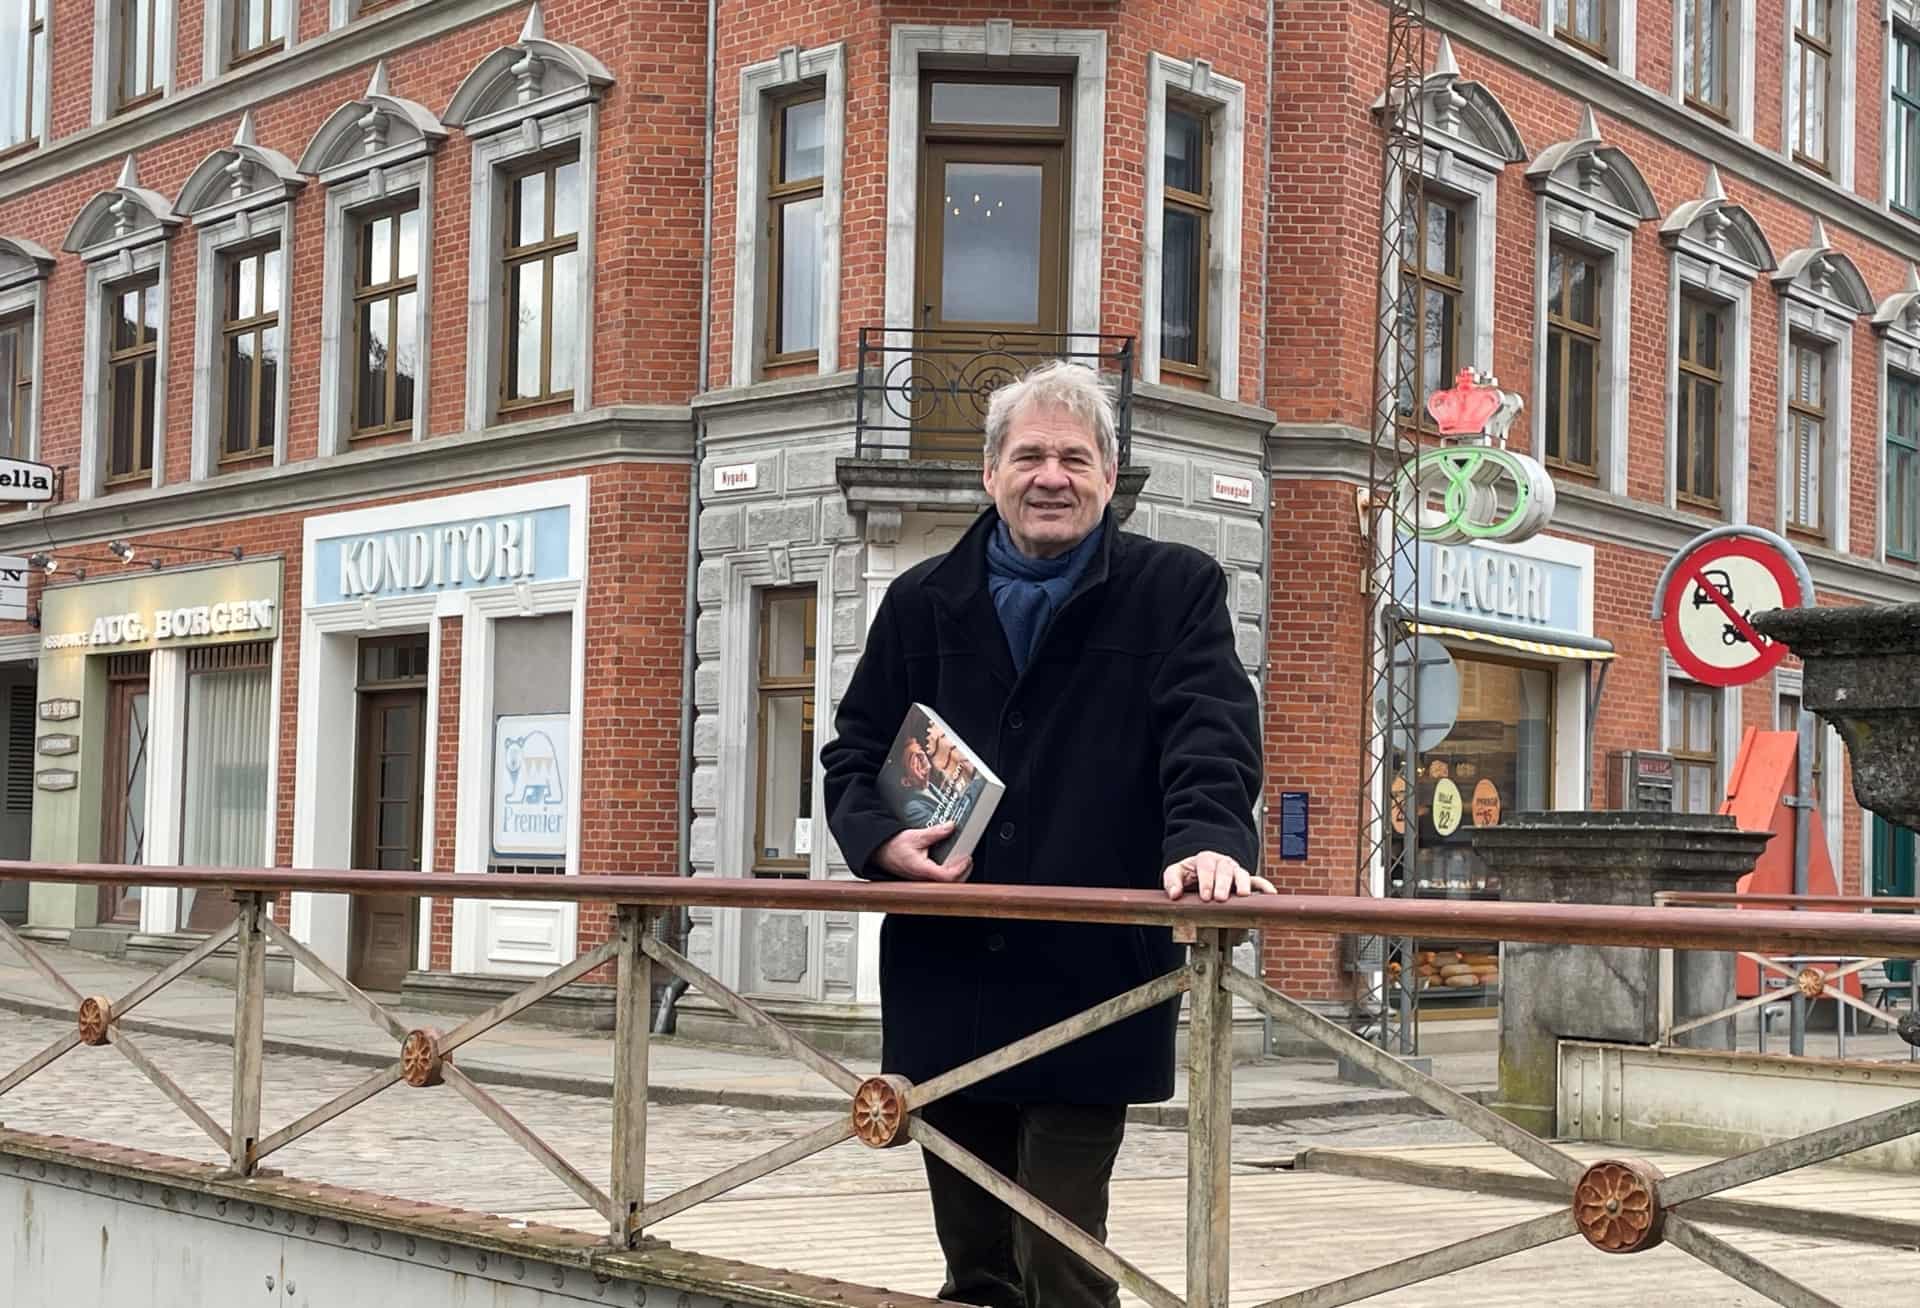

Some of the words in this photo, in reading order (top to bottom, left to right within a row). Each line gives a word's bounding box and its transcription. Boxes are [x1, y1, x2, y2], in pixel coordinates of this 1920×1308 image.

[340, 516, 536, 597] KONDITORI
[1431, 545, 1551, 624] BAGERI
[153, 598, 274, 640] BORGEN
[503, 806, 563, 833] Premier
